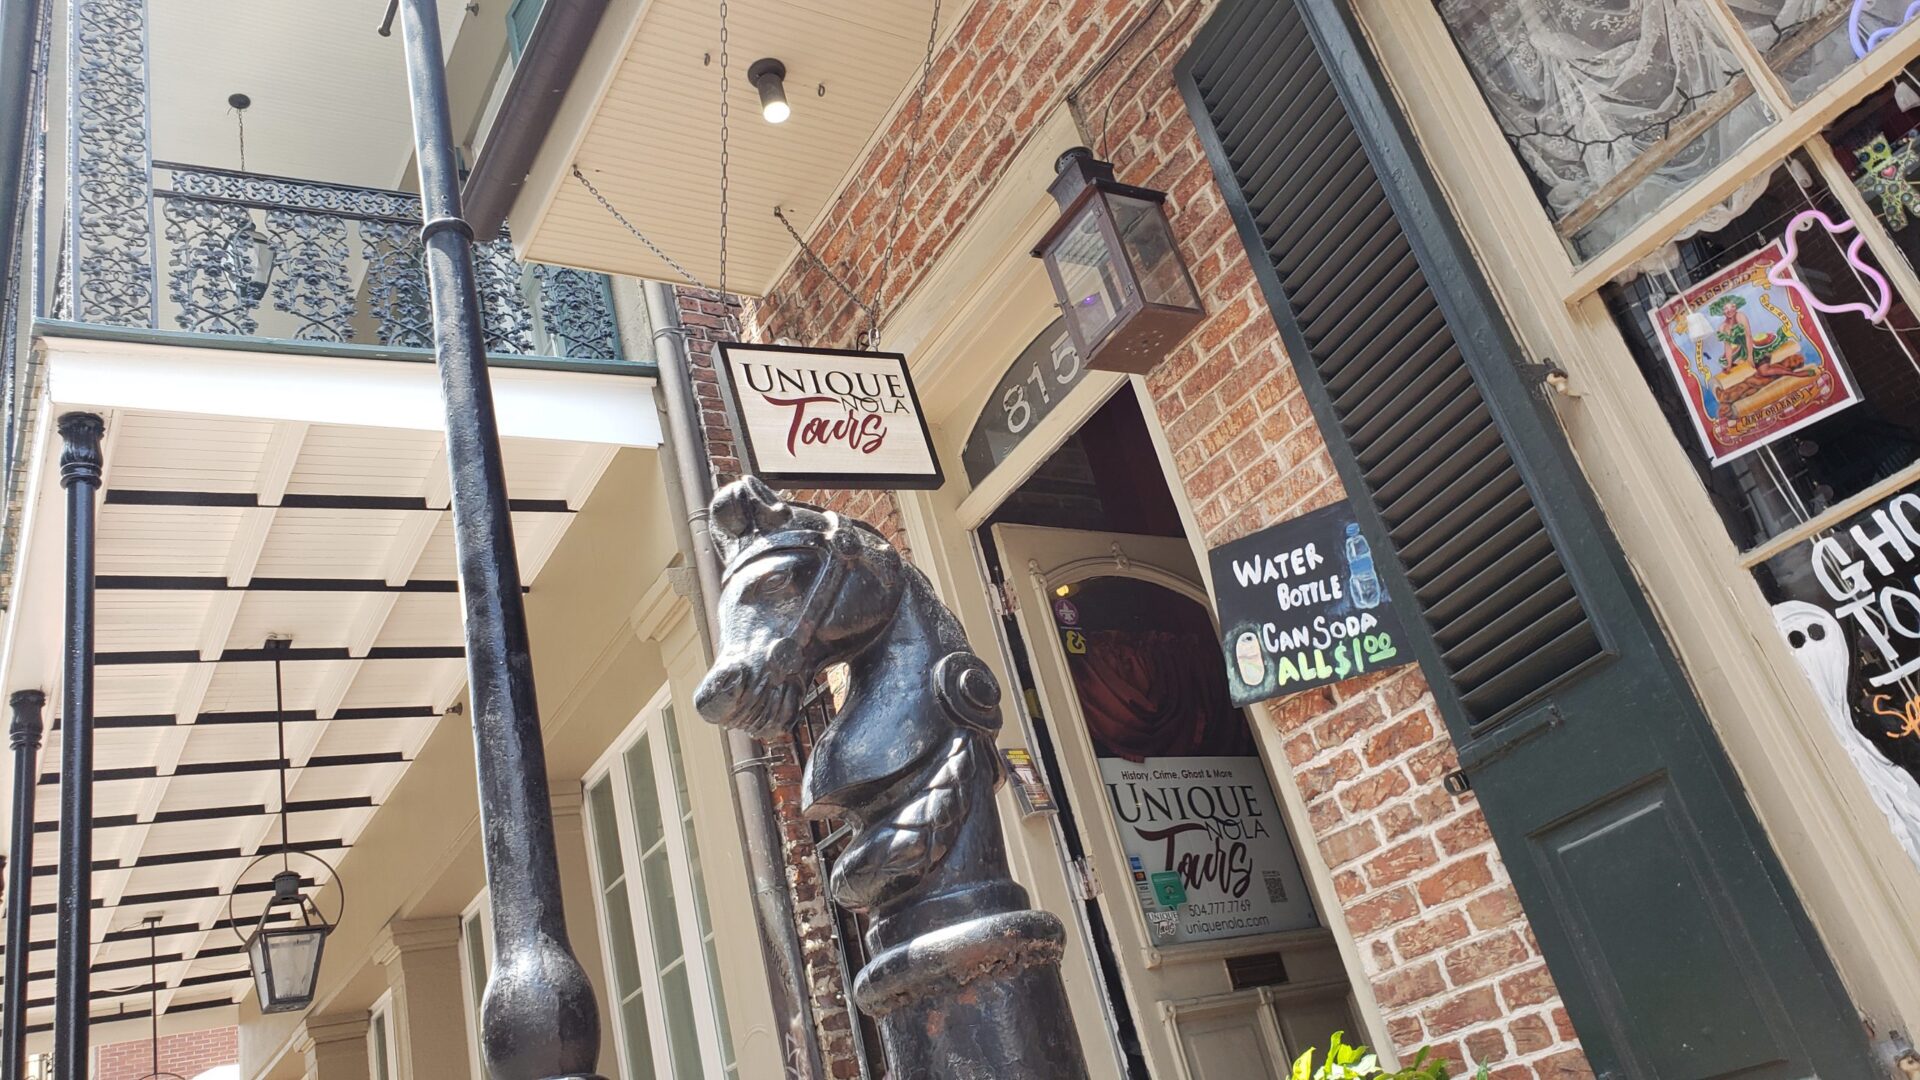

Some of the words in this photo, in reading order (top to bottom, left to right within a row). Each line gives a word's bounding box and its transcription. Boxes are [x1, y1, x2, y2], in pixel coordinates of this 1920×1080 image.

[739, 362, 905, 399] UNIQUE
[1003, 331, 1080, 433] 815
[840, 396, 910, 414] NOLA
[761, 393, 888, 457] Tours
[1232, 542, 1324, 588] WATER
[1276, 574, 1343, 611] BOTTLE
[1262, 622, 1309, 653] CAN
[1312, 612, 1378, 651] SODA
[1278, 649, 1332, 686] ALL
[1121, 770, 1152, 781] History,
[1153, 769, 1180, 779] Crime,
[1181, 769, 1204, 779] Ghost
[1213, 769, 1233, 778] More
[1106, 783, 1262, 823] UNIQUE
[1204, 818, 1270, 841] NOLA
[1185, 914, 1270, 935] uniquenola.com
[1188, 899, 1252, 917] 504.777.7769
